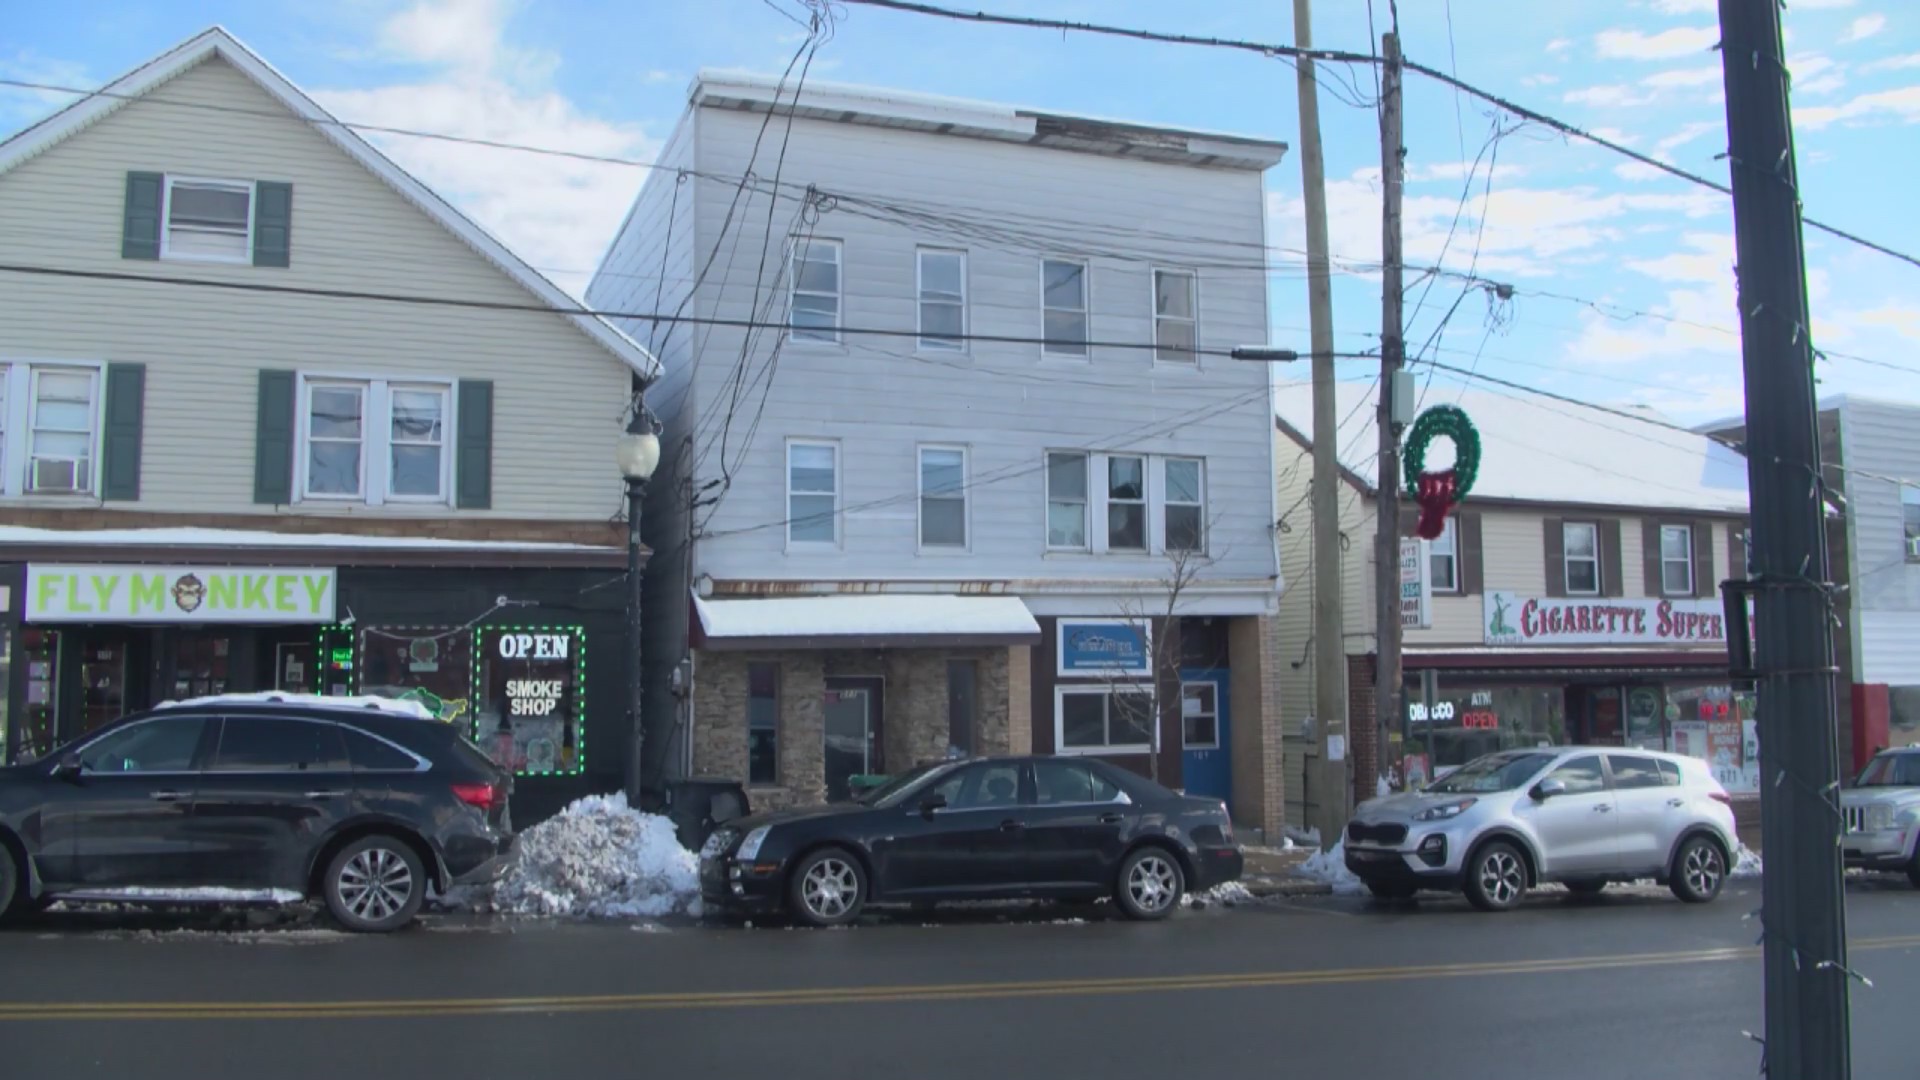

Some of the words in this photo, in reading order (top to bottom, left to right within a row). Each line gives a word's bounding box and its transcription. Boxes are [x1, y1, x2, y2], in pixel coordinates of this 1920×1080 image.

[37, 573, 120, 613] FLY
[128, 572, 330, 614] MNKEY
[1520, 598, 1647, 638] CIGARETTE
[1656, 600, 1723, 639] SUPER
[499, 634, 569, 658] OPEN
[505, 680, 563, 698] SMOKE
[1471, 690, 1492, 706] ATM
[511, 699, 556, 716] SHOP
[1462, 713, 1498, 729] OPEN
